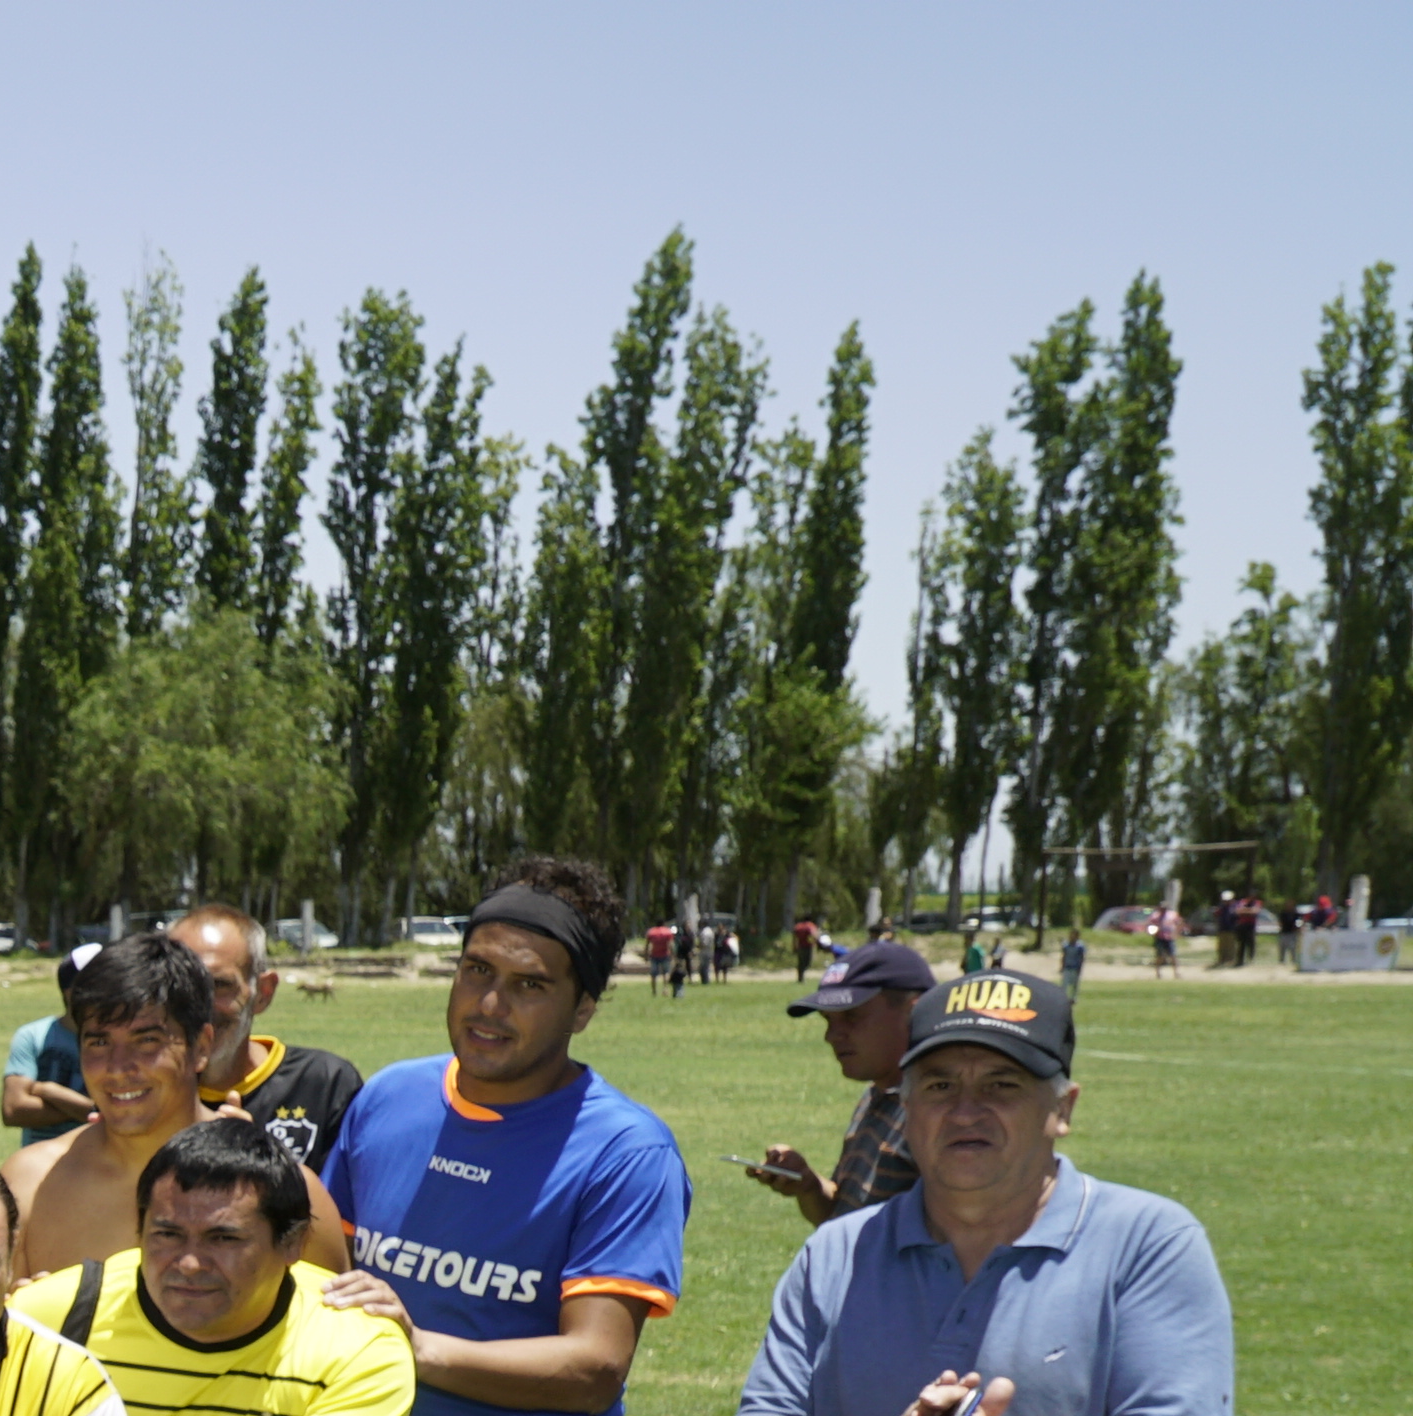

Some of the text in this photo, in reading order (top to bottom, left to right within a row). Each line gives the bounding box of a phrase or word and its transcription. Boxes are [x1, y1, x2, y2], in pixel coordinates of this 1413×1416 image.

[945, 981, 1032, 1014] HUAR
[429, 1155, 491, 1184] KNOCK
[354, 1226, 542, 1303] DICETOURS
